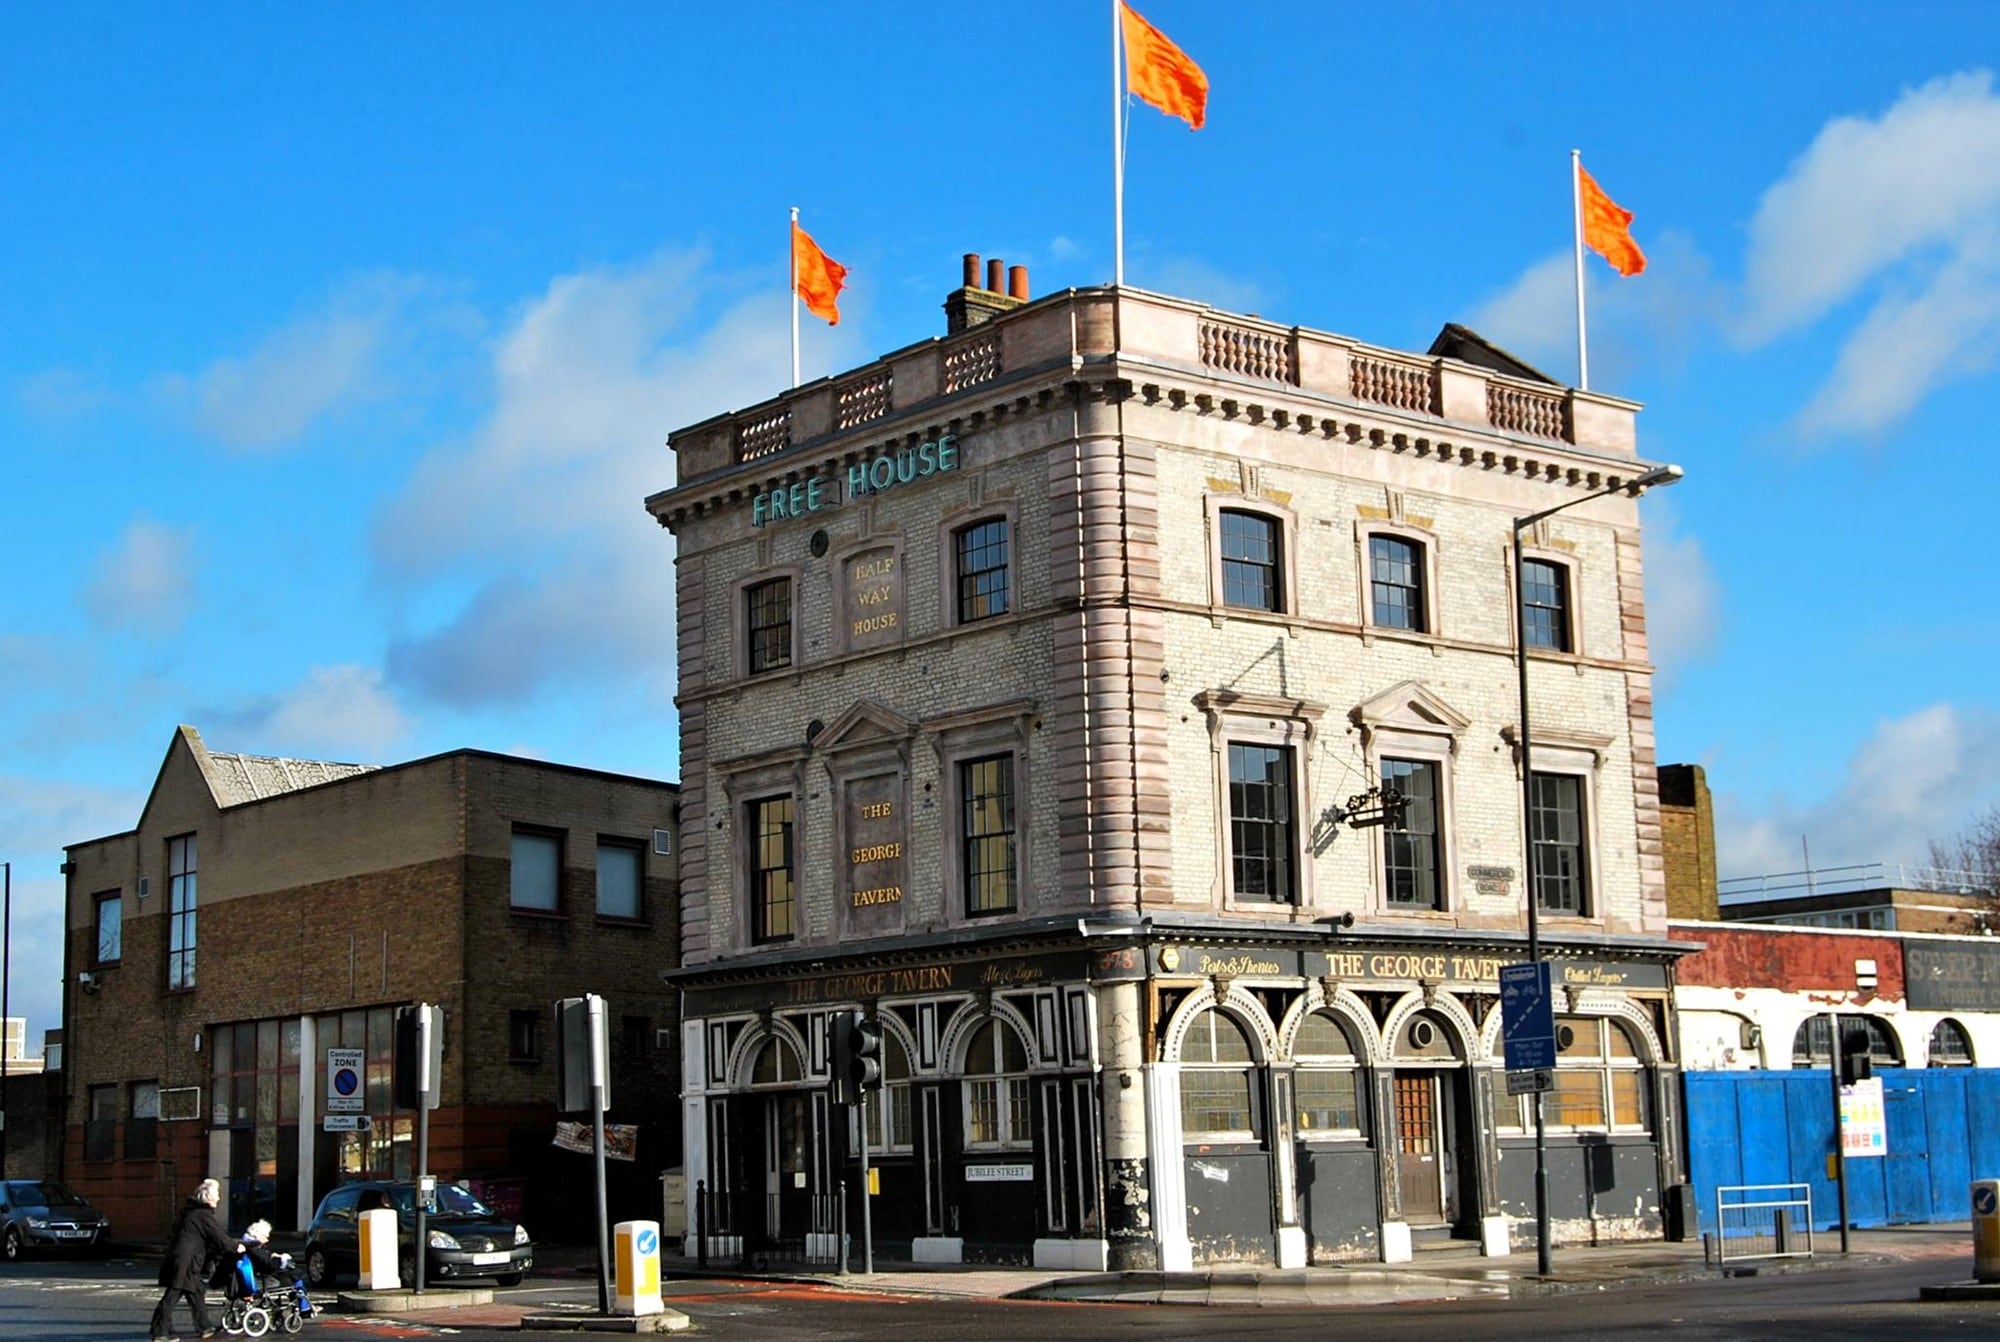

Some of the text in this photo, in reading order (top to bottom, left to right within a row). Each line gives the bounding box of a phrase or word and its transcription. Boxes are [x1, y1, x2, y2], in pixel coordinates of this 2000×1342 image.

[753, 434, 959, 527] FREE HOUSE
[856, 558, 894, 580] HALF
[859, 586, 890, 606] WAY
[854, 612, 897, 636] HOUSE
[862, 803, 892, 819] THE
[1326, 954, 1364, 977] THE
[1370, 955, 1446, 978] GEORGE
[788, 966, 952, 1002] THE GEORGE TAVERN
[334, 1059, 357, 1067] ZONE
[967, 1167, 996, 1179] JUBILEE
[996, 1167, 1024, 1177] STREET
